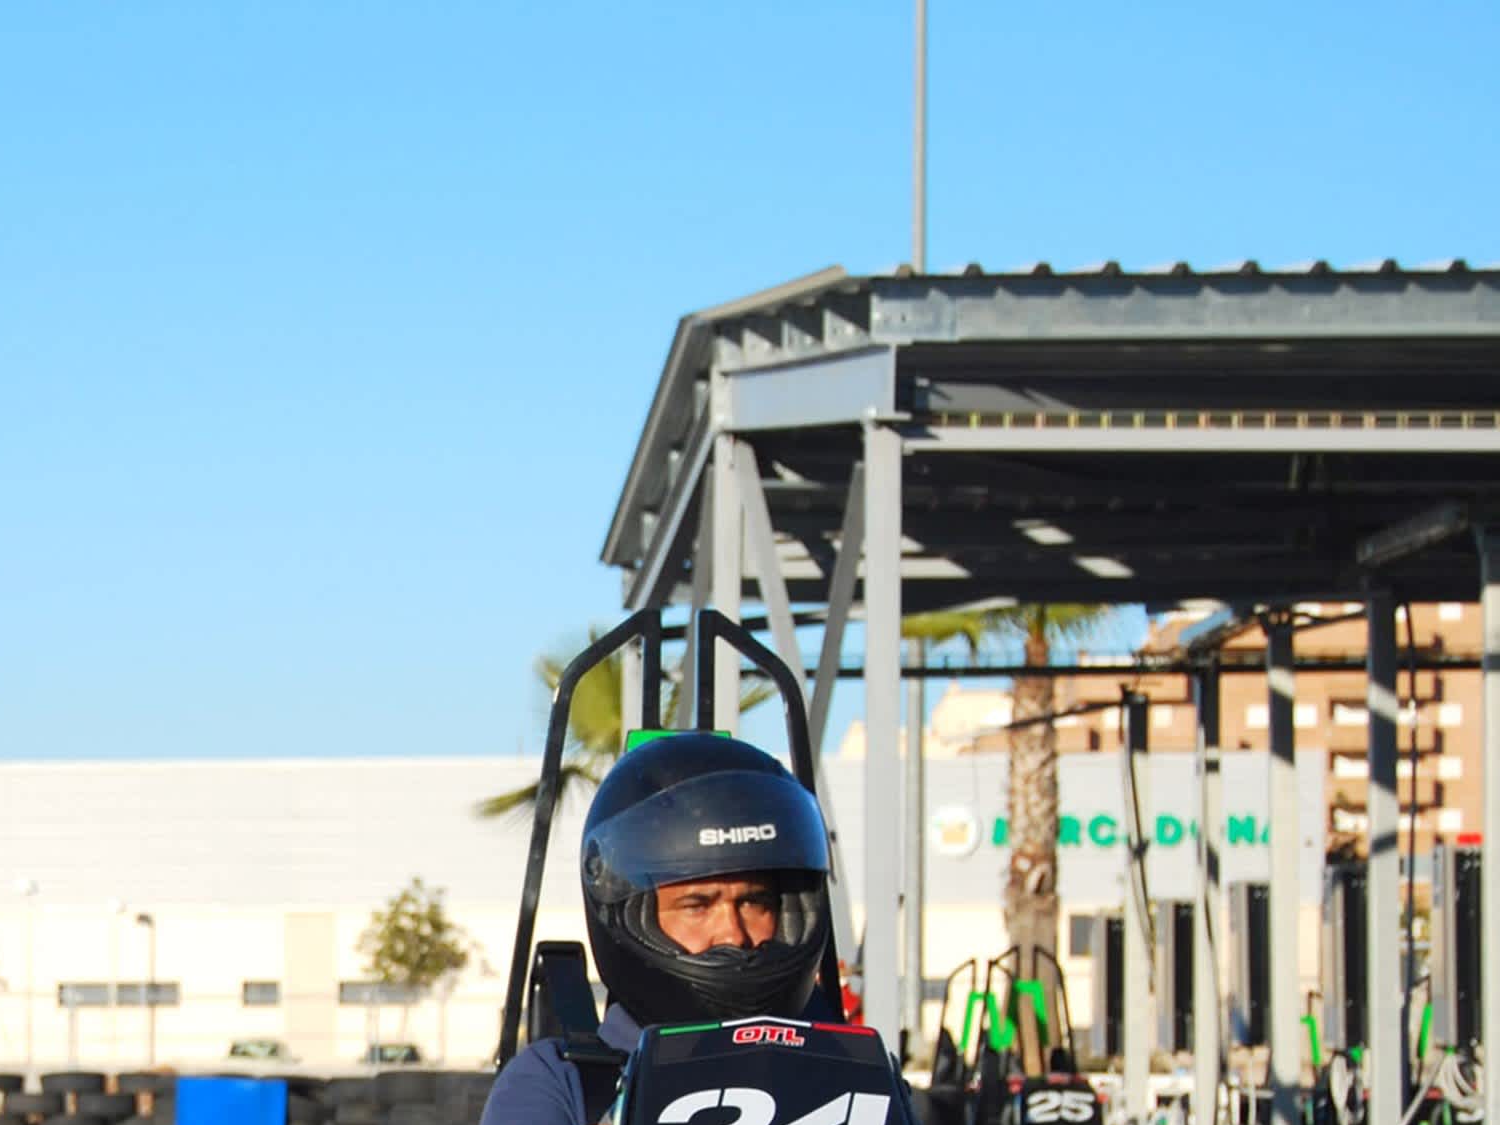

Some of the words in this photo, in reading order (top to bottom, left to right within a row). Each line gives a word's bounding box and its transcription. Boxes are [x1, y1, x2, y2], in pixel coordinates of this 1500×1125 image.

[699, 823, 777, 846] SHIRO
[732, 1025, 805, 1045] OTL
[1026, 1089, 1097, 1124] 25
